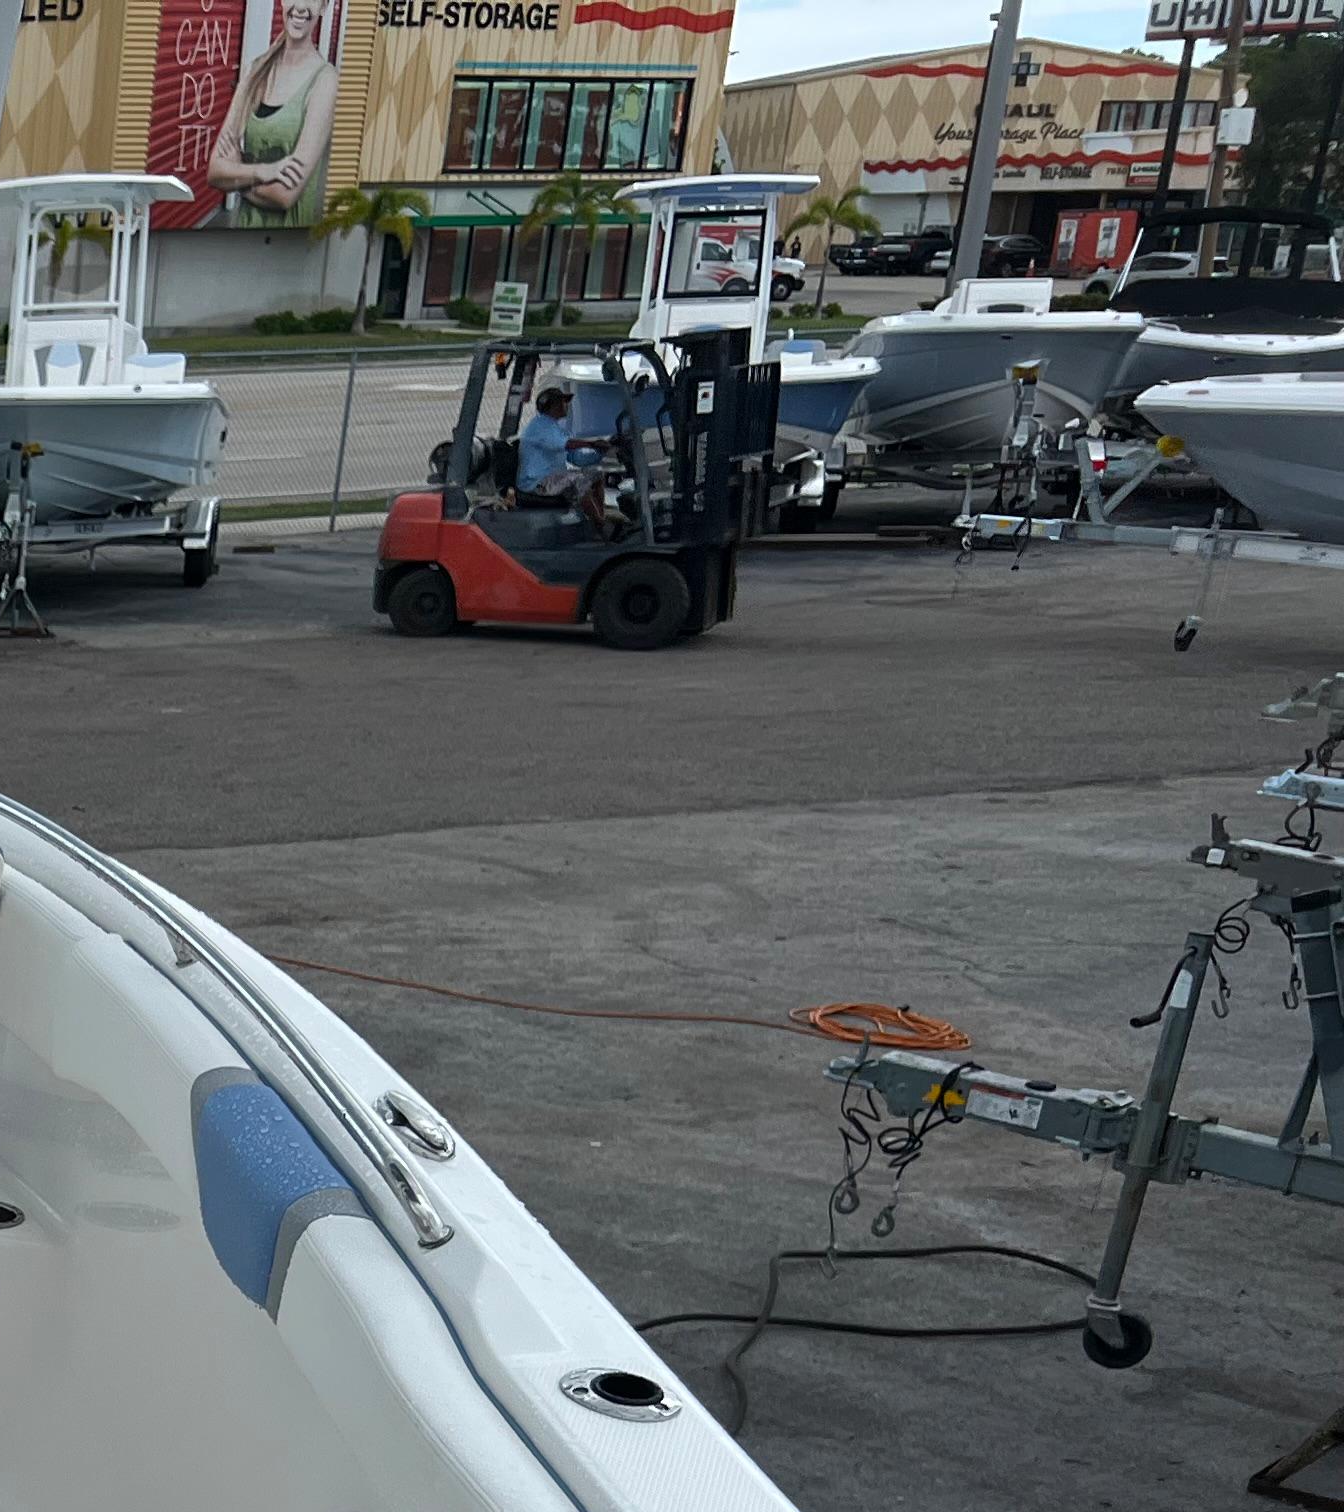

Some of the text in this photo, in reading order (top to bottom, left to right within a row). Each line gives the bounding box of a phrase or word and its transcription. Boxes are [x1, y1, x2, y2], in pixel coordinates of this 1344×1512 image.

[378, 1, 560, 30] SELF-STORAGE
[176, 19, 232, 66] CAN
[180, 72, 216, 119] DO
